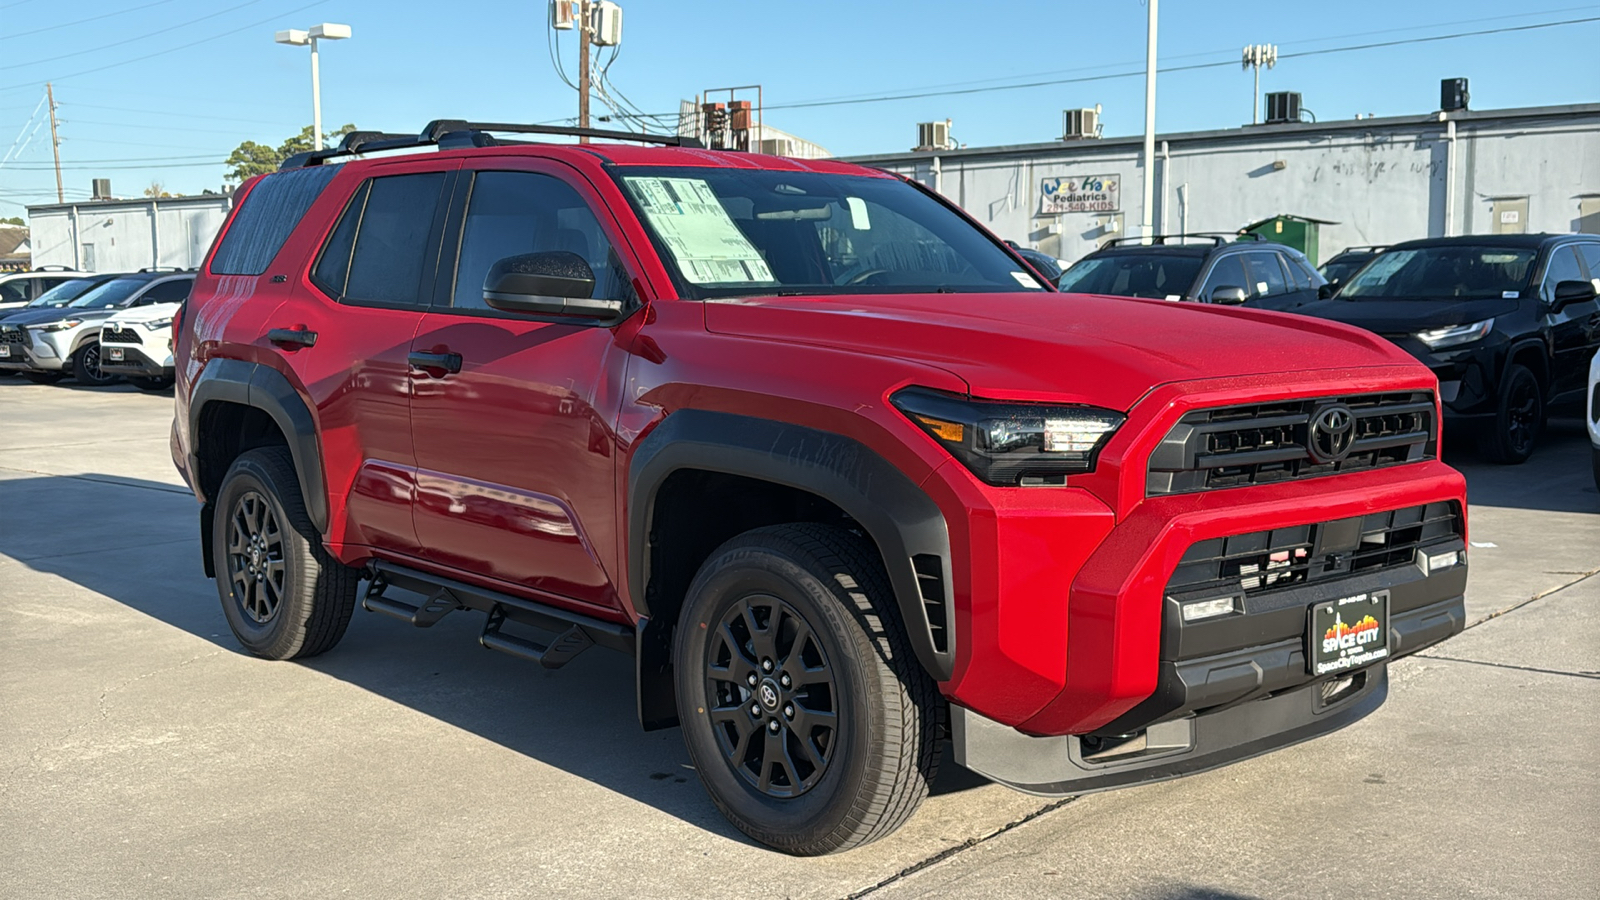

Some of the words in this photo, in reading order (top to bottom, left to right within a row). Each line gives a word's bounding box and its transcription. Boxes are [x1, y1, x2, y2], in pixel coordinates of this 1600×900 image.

[1044, 178, 1078, 195] Wee
[1081, 176, 1117, 192] Kare
[1047, 201, 1114, 213] 281-540-KIDS
[1053, 193, 1107, 203] Pediatrics
[1322, 632, 1356, 653] SPACE
[1356, 627, 1379, 645] CITY
[1317, 649, 1388, 673] SpaceCityToyota.com
